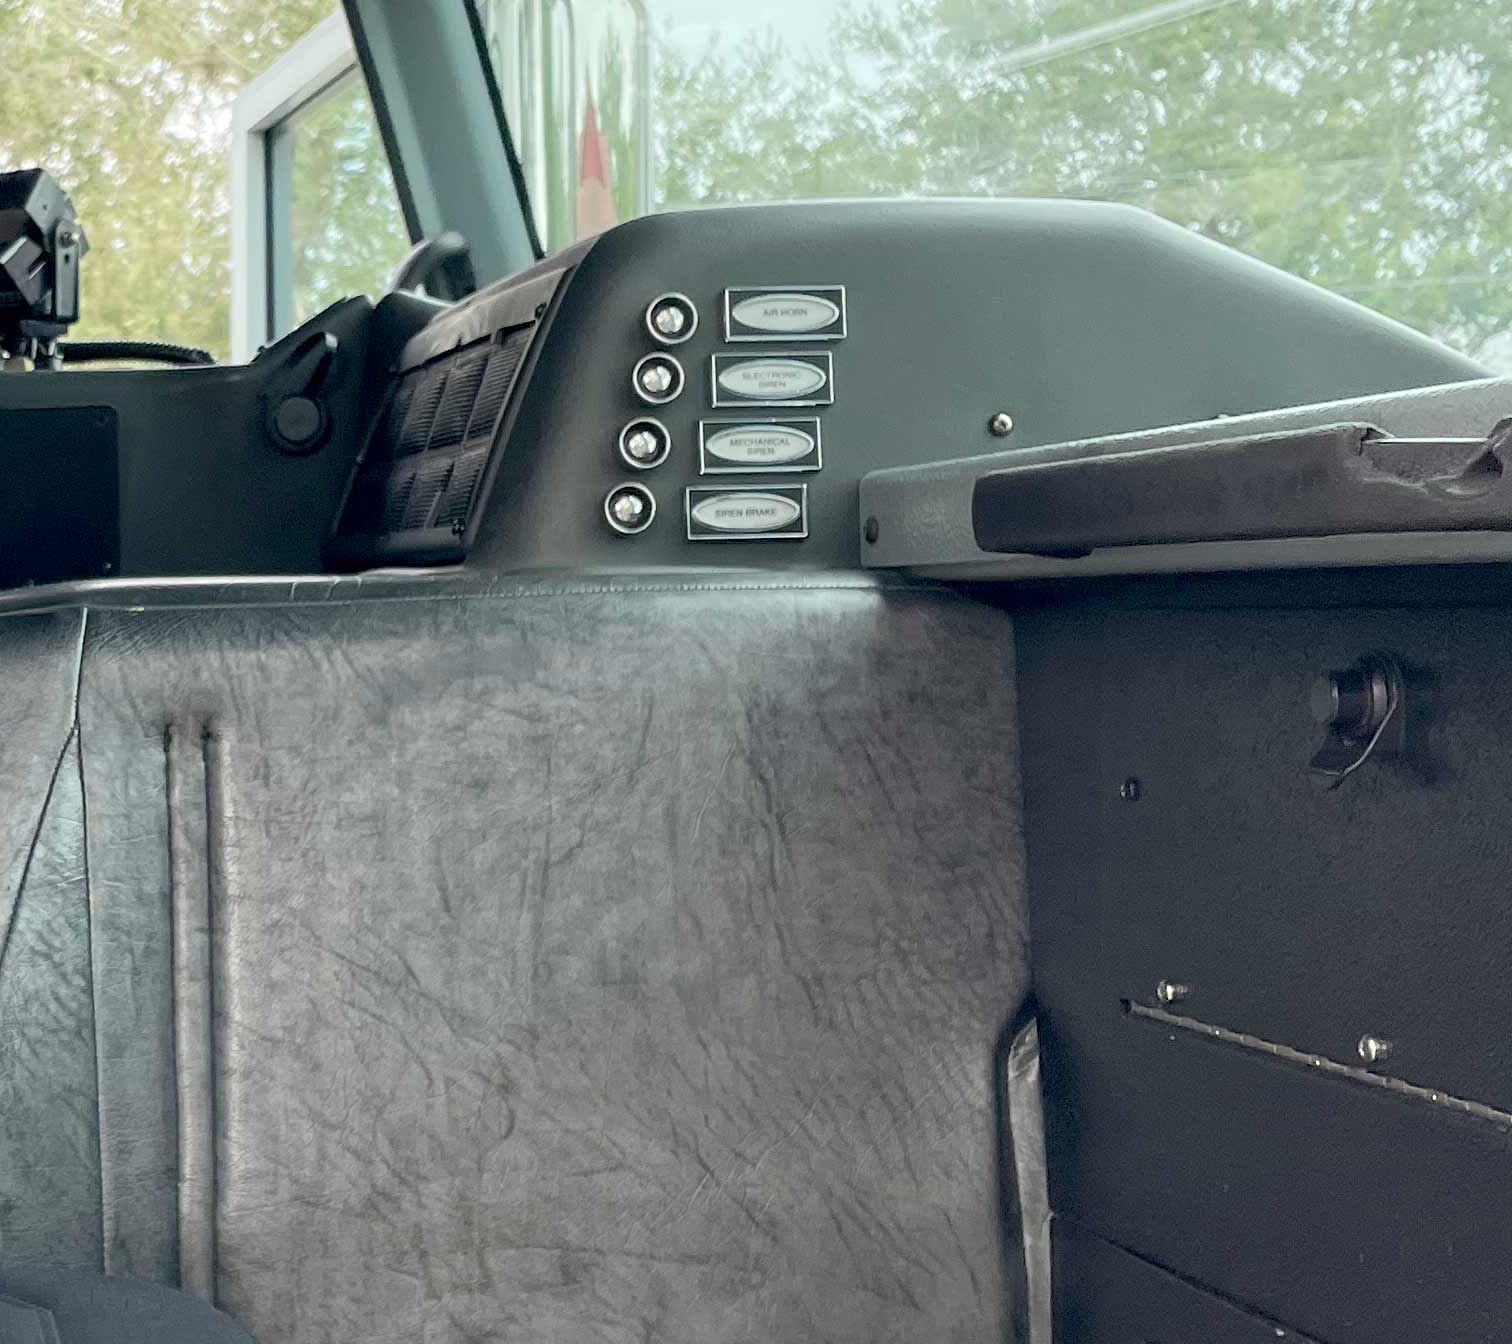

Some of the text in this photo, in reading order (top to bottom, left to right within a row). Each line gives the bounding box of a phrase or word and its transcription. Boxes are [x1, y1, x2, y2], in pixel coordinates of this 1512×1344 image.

[762, 307, 808, 317] AIR HORN
[729, 437, 791, 447] MECHANICAL
[714, 507, 777, 518] SIREN BRAKE
